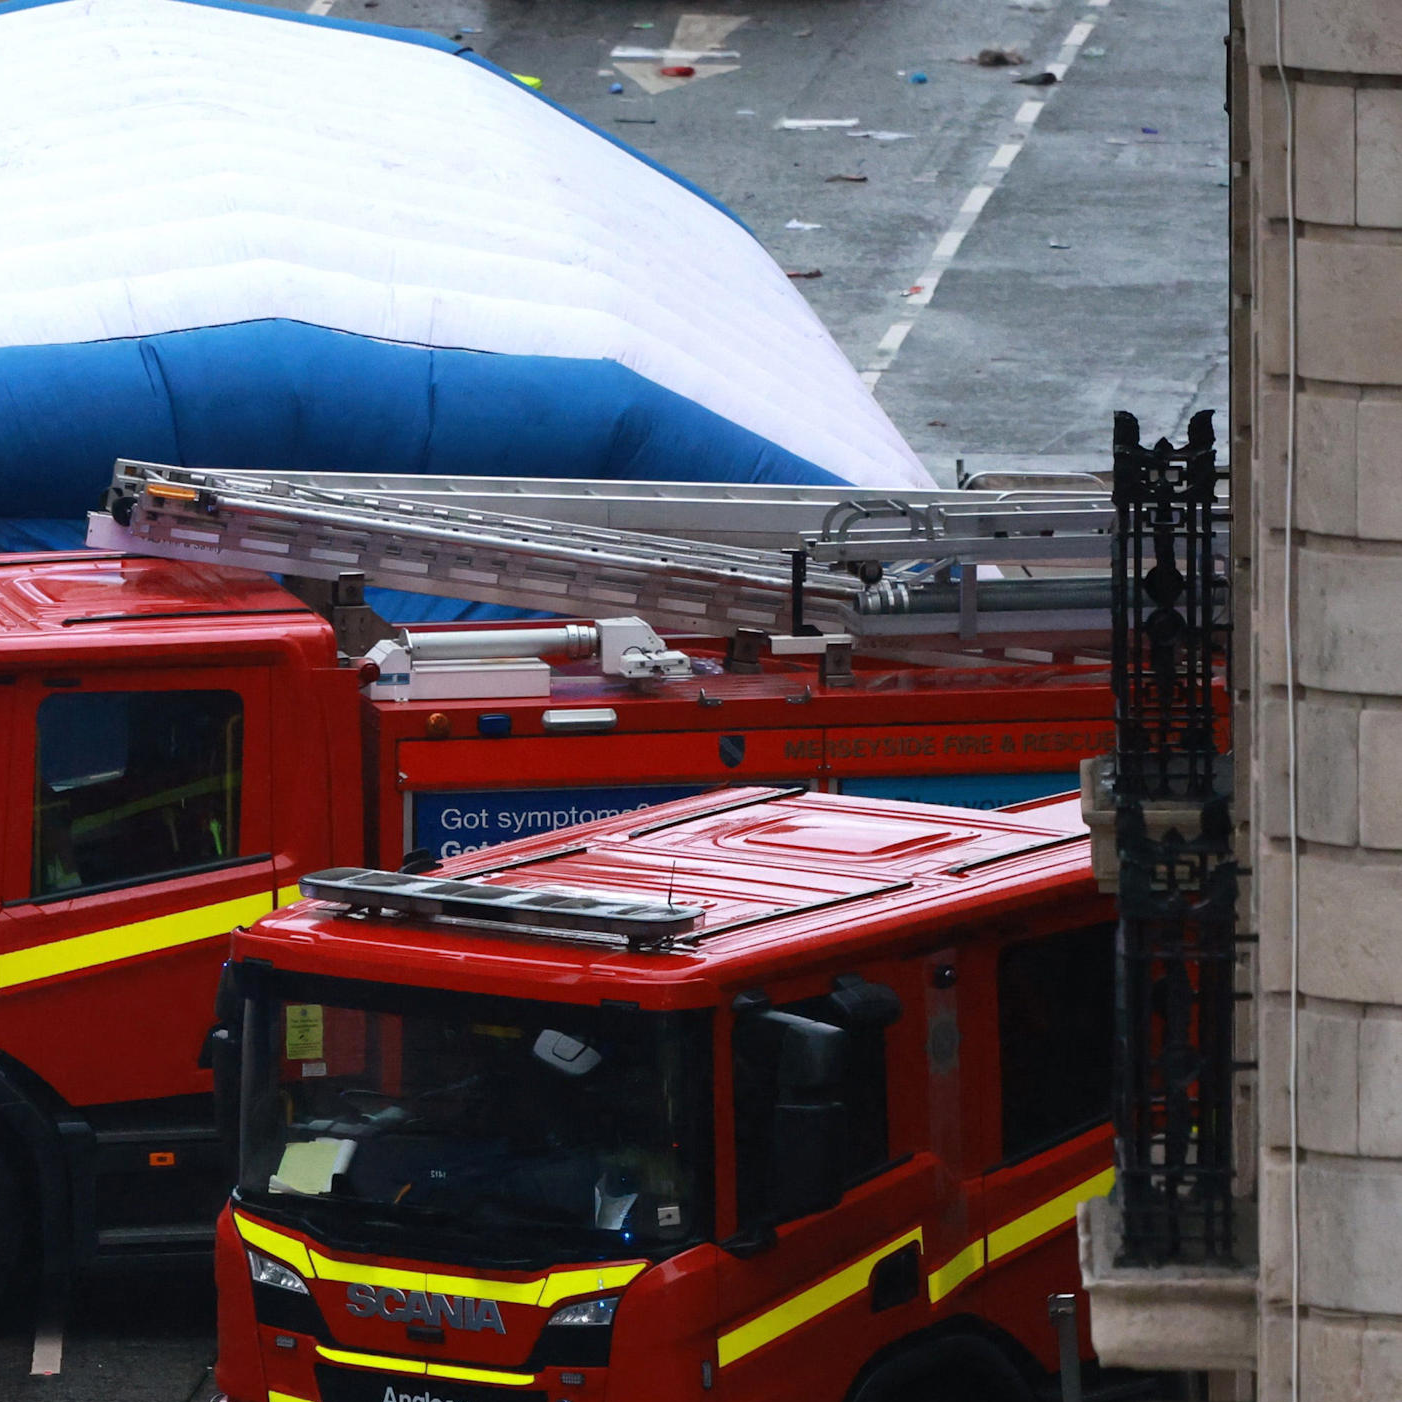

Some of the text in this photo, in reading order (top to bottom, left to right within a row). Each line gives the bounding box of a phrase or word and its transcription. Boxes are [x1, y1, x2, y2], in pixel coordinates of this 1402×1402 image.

[783, 736, 936, 760] MERSEYSIDE
[944, 734, 993, 755] FIRE
[1000, 734, 1015, 752] &
[441, 803, 650, 830] Got symptom
[346, 1283, 507, 1335] SCANIA
